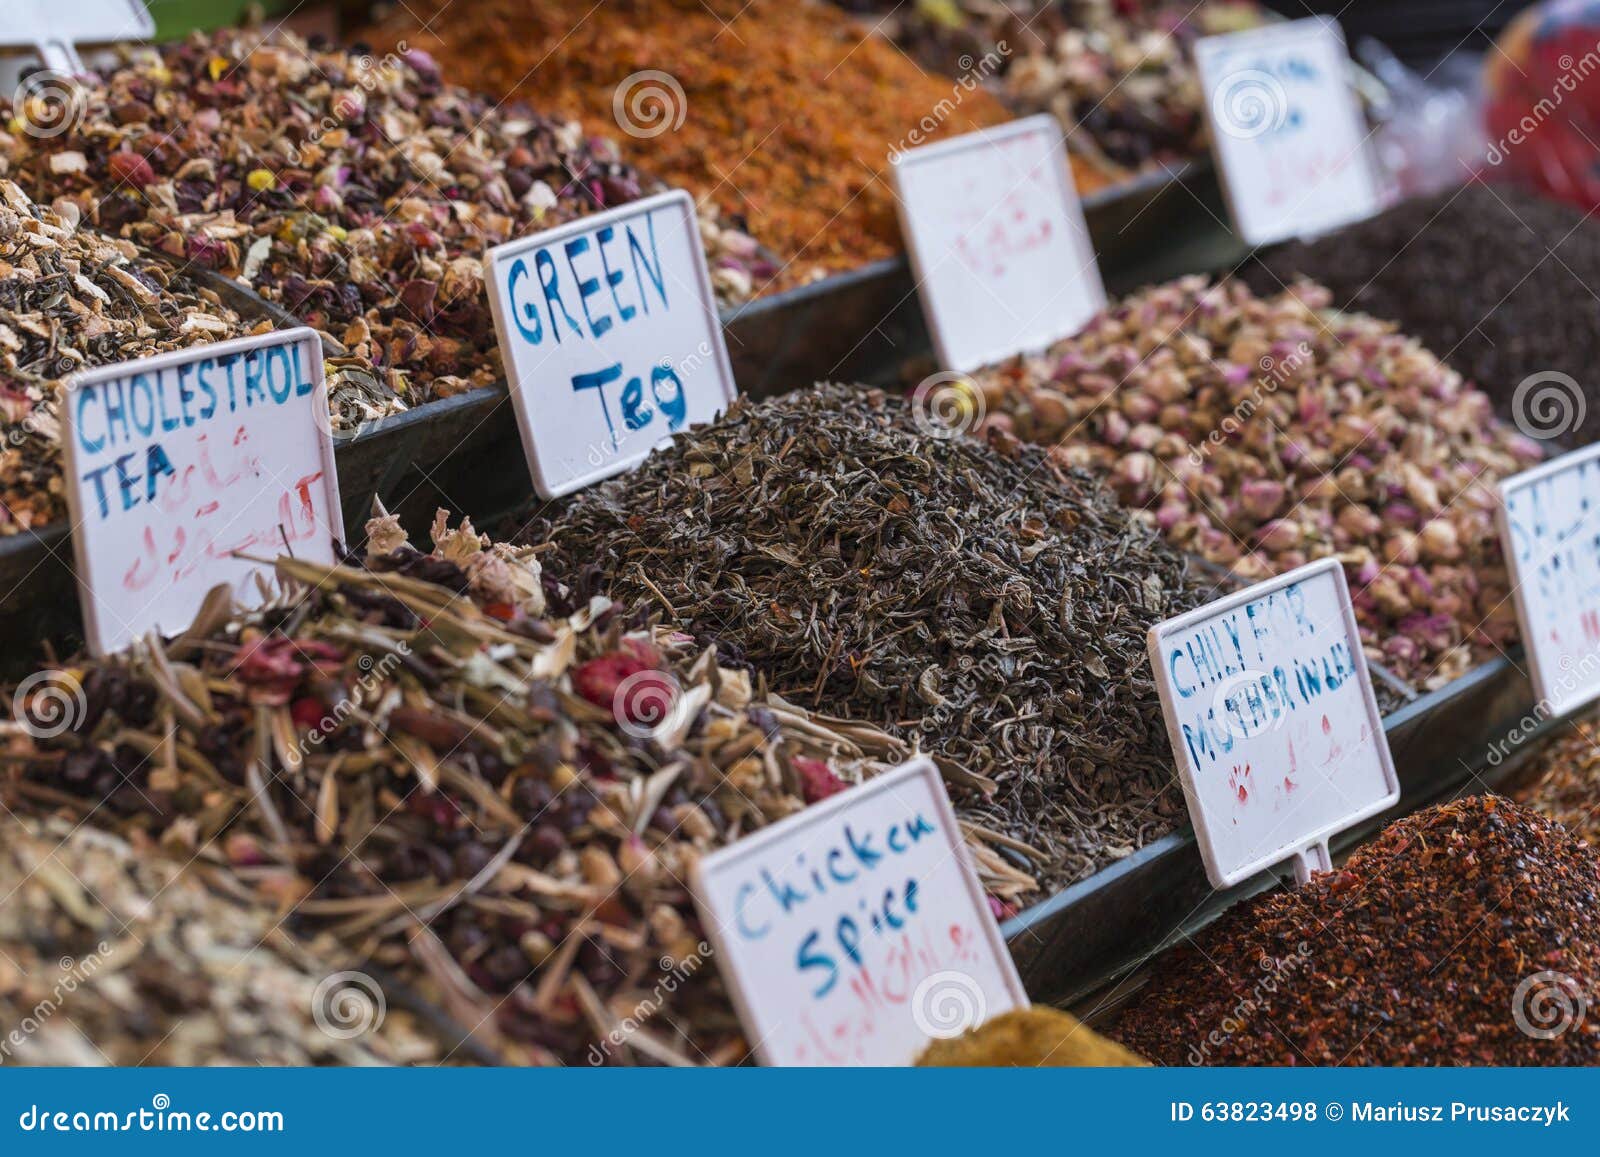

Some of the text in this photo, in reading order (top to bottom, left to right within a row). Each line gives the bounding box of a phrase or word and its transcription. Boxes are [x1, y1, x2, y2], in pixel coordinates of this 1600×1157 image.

[507, 211, 670, 346] GREEN
[76, 344, 313, 454] CHOLESTROL
[83, 444, 175, 519] TEA
[1181, 664, 1296, 772] MOTHER
[733, 813, 937, 940] Chicken
